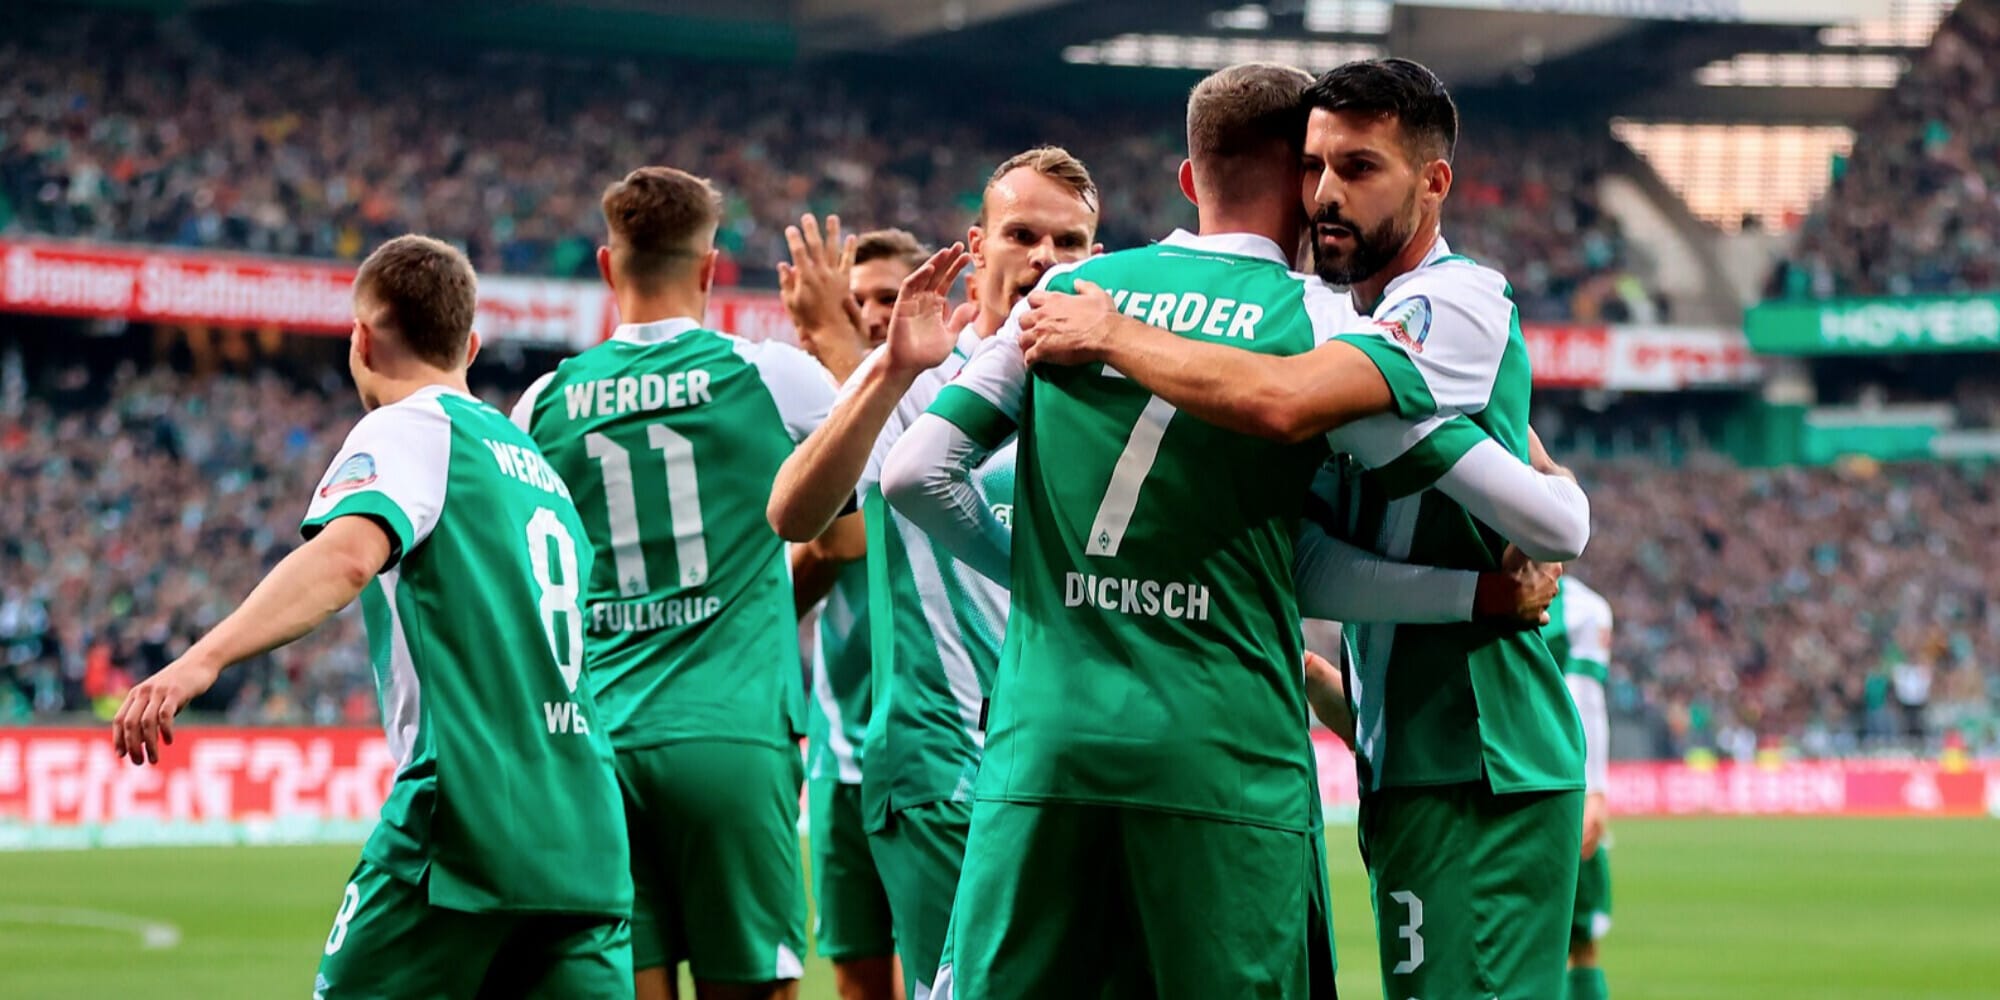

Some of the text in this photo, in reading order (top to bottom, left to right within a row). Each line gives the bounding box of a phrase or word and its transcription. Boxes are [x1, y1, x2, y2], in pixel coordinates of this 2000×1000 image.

[564, 370, 713, 421] WERDER
[585, 423, 709, 598] 11
[526, 505, 584, 694] 8
[325, 881, 360, 956] 8
[1390, 890, 1424, 974] 3
